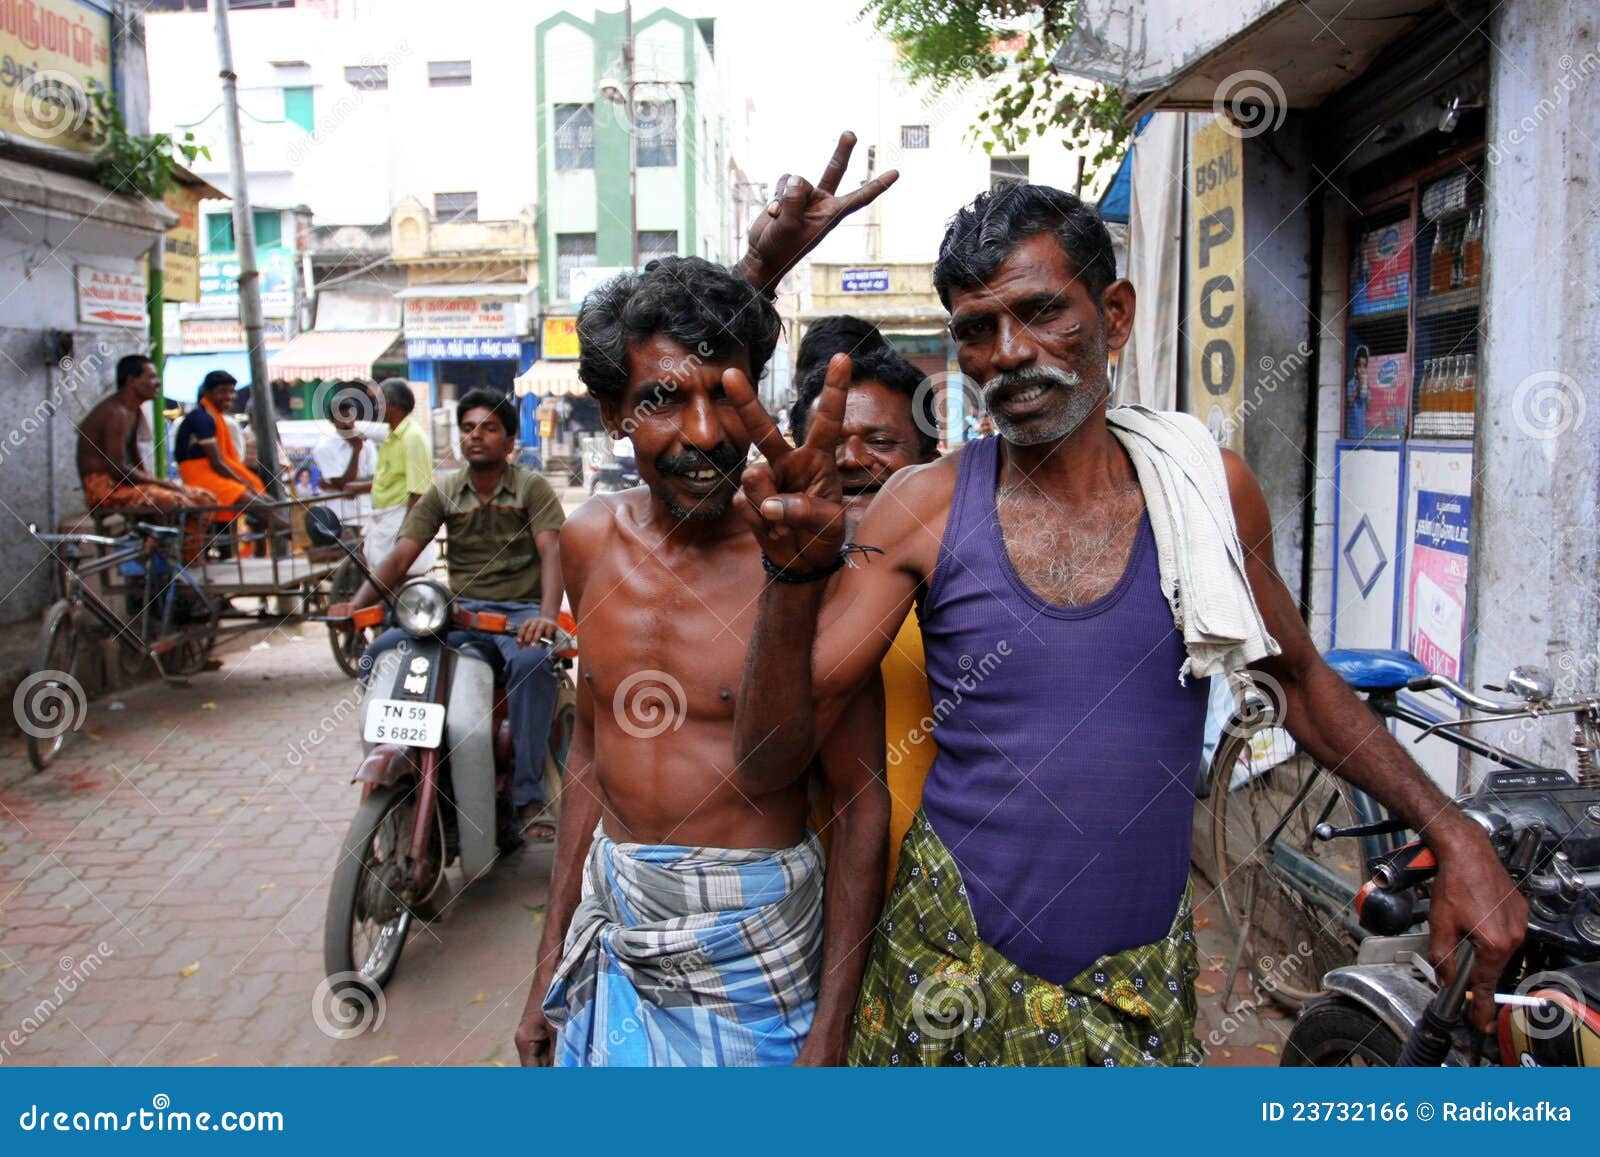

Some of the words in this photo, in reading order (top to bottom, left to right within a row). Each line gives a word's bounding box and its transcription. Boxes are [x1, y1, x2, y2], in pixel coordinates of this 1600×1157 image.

[1195, 148, 1239, 197] BSNL
[384, 705, 403, 718] TN
[408, 707, 427, 721] 59
[376, 726, 385, 738] S
[391, 727, 427, 741] 6826
